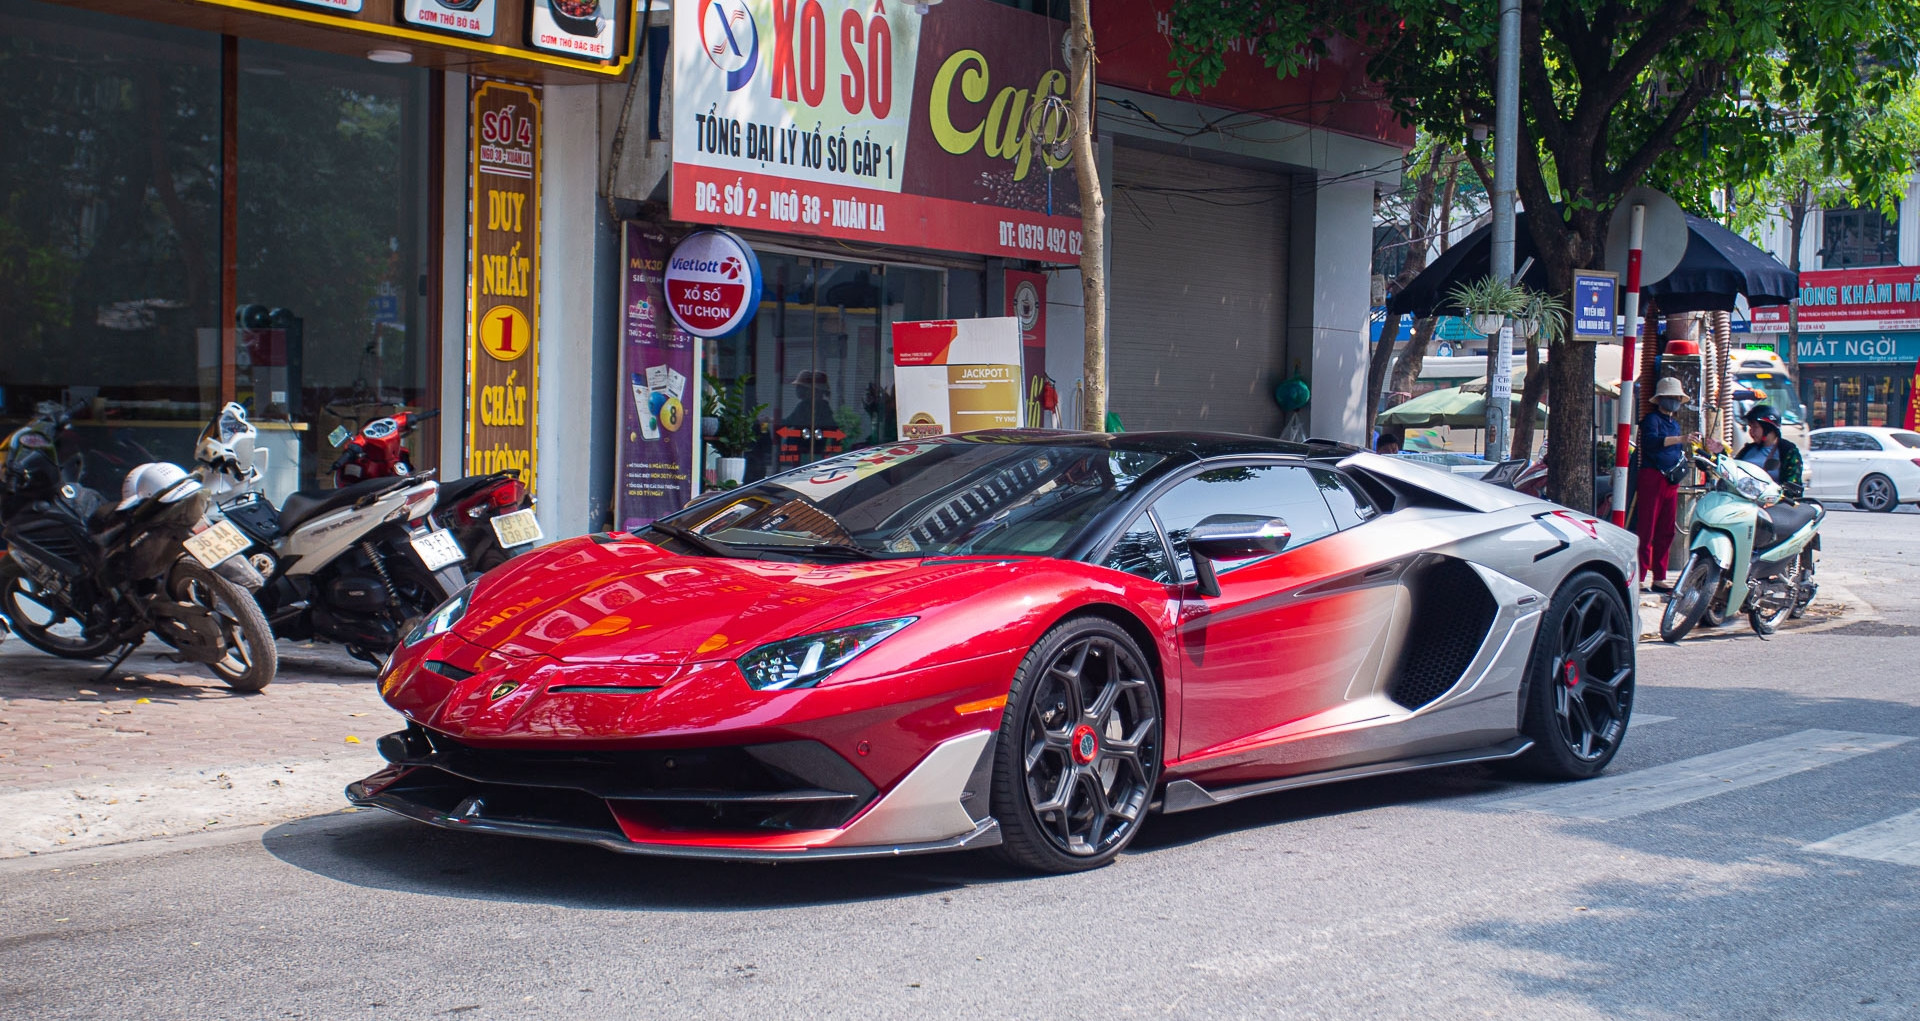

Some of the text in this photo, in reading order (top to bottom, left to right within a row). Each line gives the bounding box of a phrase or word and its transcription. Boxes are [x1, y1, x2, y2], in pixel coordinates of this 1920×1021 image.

[419, 9, 437, 22] CƠM
[469, 17, 480, 30] GÀ
[482, 104, 532, 147] SỐ 4
[695, 102, 893, 179] TỔNG ĐẠI LÝ XỔ SỐ CẤP 1
[522, 151, 532, 167] LA
[488, 190, 525, 232] DUY
[695, 181, 721, 213] ĐC:
[724, 177, 744, 216] SỐ
[747, 188, 757, 217] 2
[770, 189, 799, 223] NGÕ
[802, 195, 821, 225] 38
[832, 197, 867, 229] XUÂN
[869, 204, 885, 232] LA
[1018, 223, 1044, 251] 0379
[1046, 227, 1067, 254] 492
[482, 241, 530, 297] NHẤT
[671, 257, 718, 273] Vietlott
[684, 284, 721, 302] XỔ SỐ
[1841, 278, 1892, 305] KHÁM
[695, 305, 730, 320] CHỌN
[495, 314, 517, 353] 1
[1797, 333, 1896, 357] MẮT NGỜI
[961, 368, 1010, 379] JACKPOT 1
[480, 369, 526, 426] CHẤT
[670, 406, 676, 425] 8
[192, 526, 231, 551] 36-AA
[202, 534, 246, 564] 115.36
